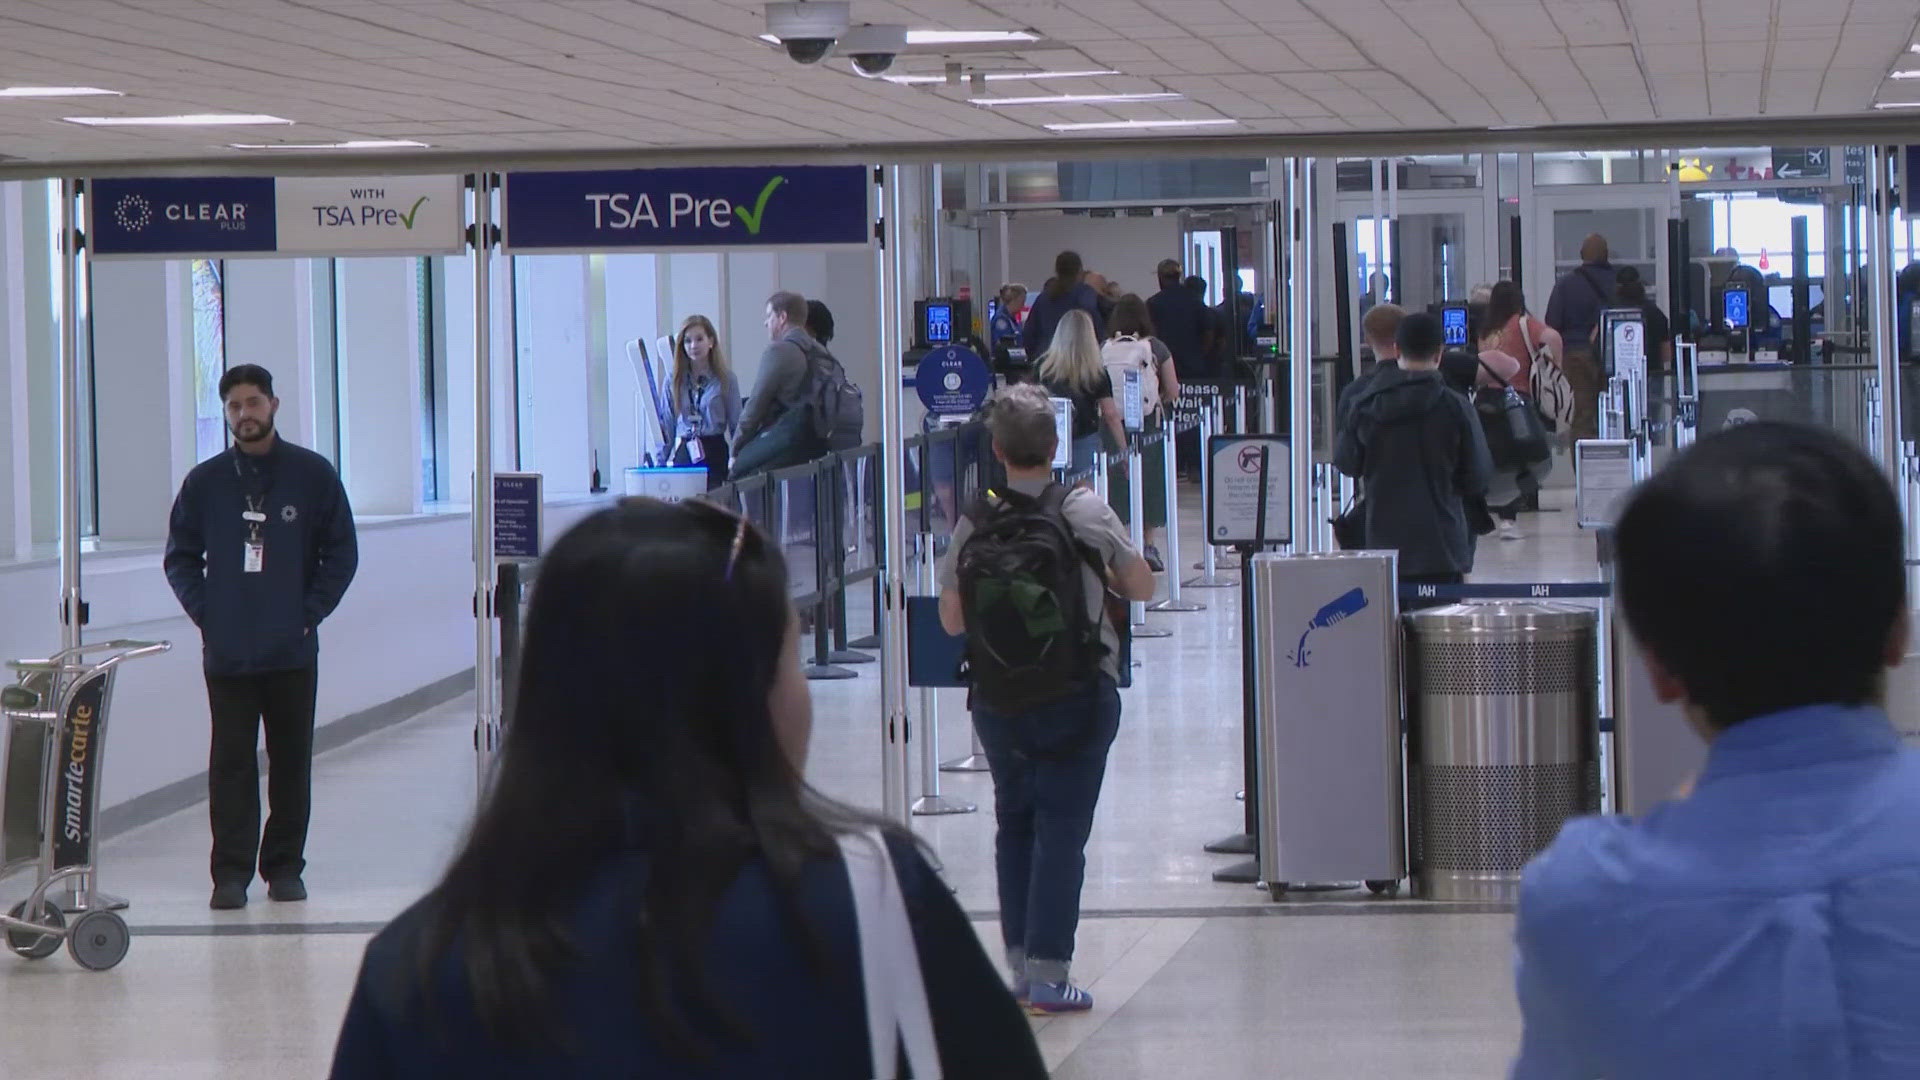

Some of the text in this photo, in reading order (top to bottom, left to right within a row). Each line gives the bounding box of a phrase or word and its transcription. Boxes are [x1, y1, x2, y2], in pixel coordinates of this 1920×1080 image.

[350, 188, 385, 199] WITH
[165, 203, 246, 221] CLEAR
[312, 205, 397, 226] TSA Pre
[585, 193, 731, 229] TSA Pre
[220, 221, 246, 231] PLUS
[941, 360, 962, 368] CLEAR
[1172, 396, 1203, 409] Wait
[1172, 410, 1198, 422] Her
[1418, 585, 1436, 597] IAH
[1531, 585, 1549, 597] IAH
[64, 704, 93, 843] smartecarte
